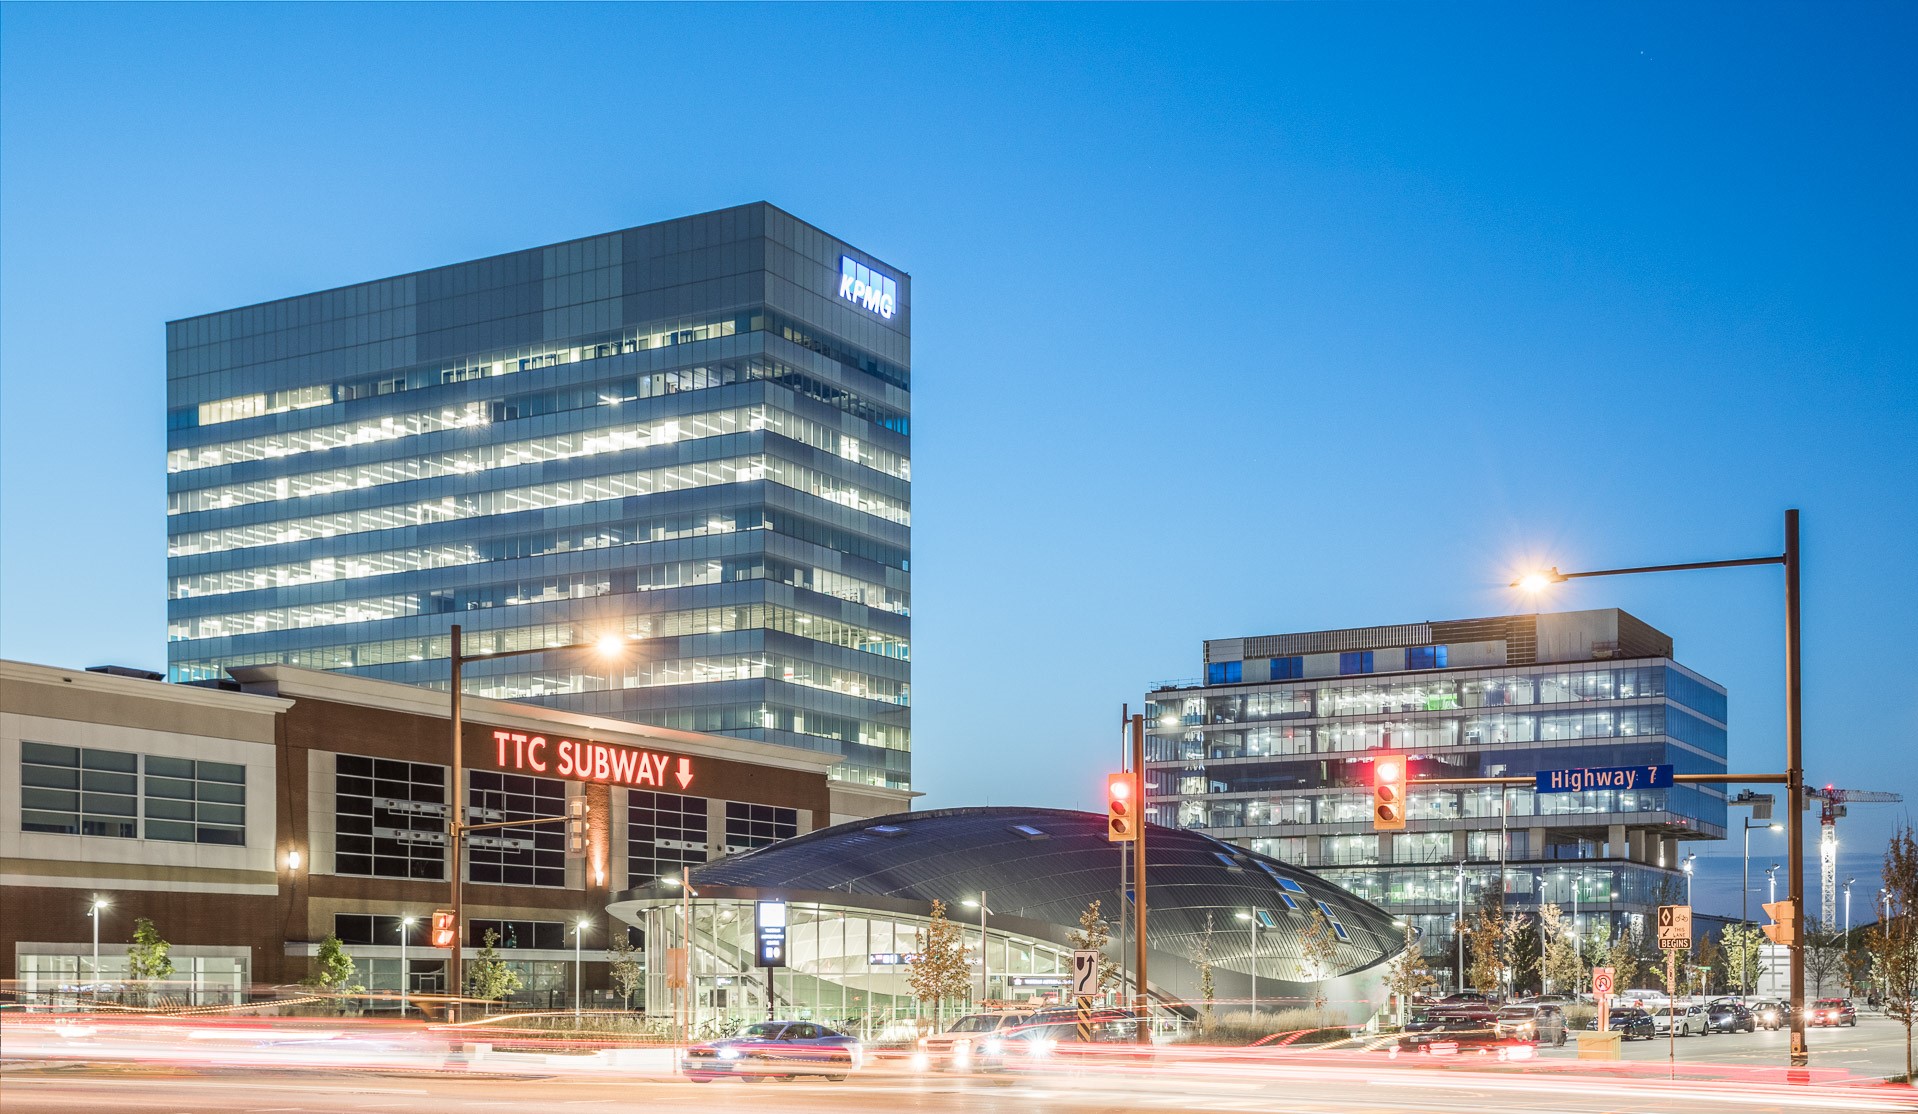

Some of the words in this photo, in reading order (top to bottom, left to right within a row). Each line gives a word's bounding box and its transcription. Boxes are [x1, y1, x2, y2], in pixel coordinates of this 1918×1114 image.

[839, 273, 893, 320] KPMG
[493, 730, 547, 772] TTC
[557, 740, 670, 787] SUBWAY
[1551, 768, 1636, 792] Highway
[1647, 766, 1658, 784] 7
[1661, 939, 1689, 948] BEGINS
